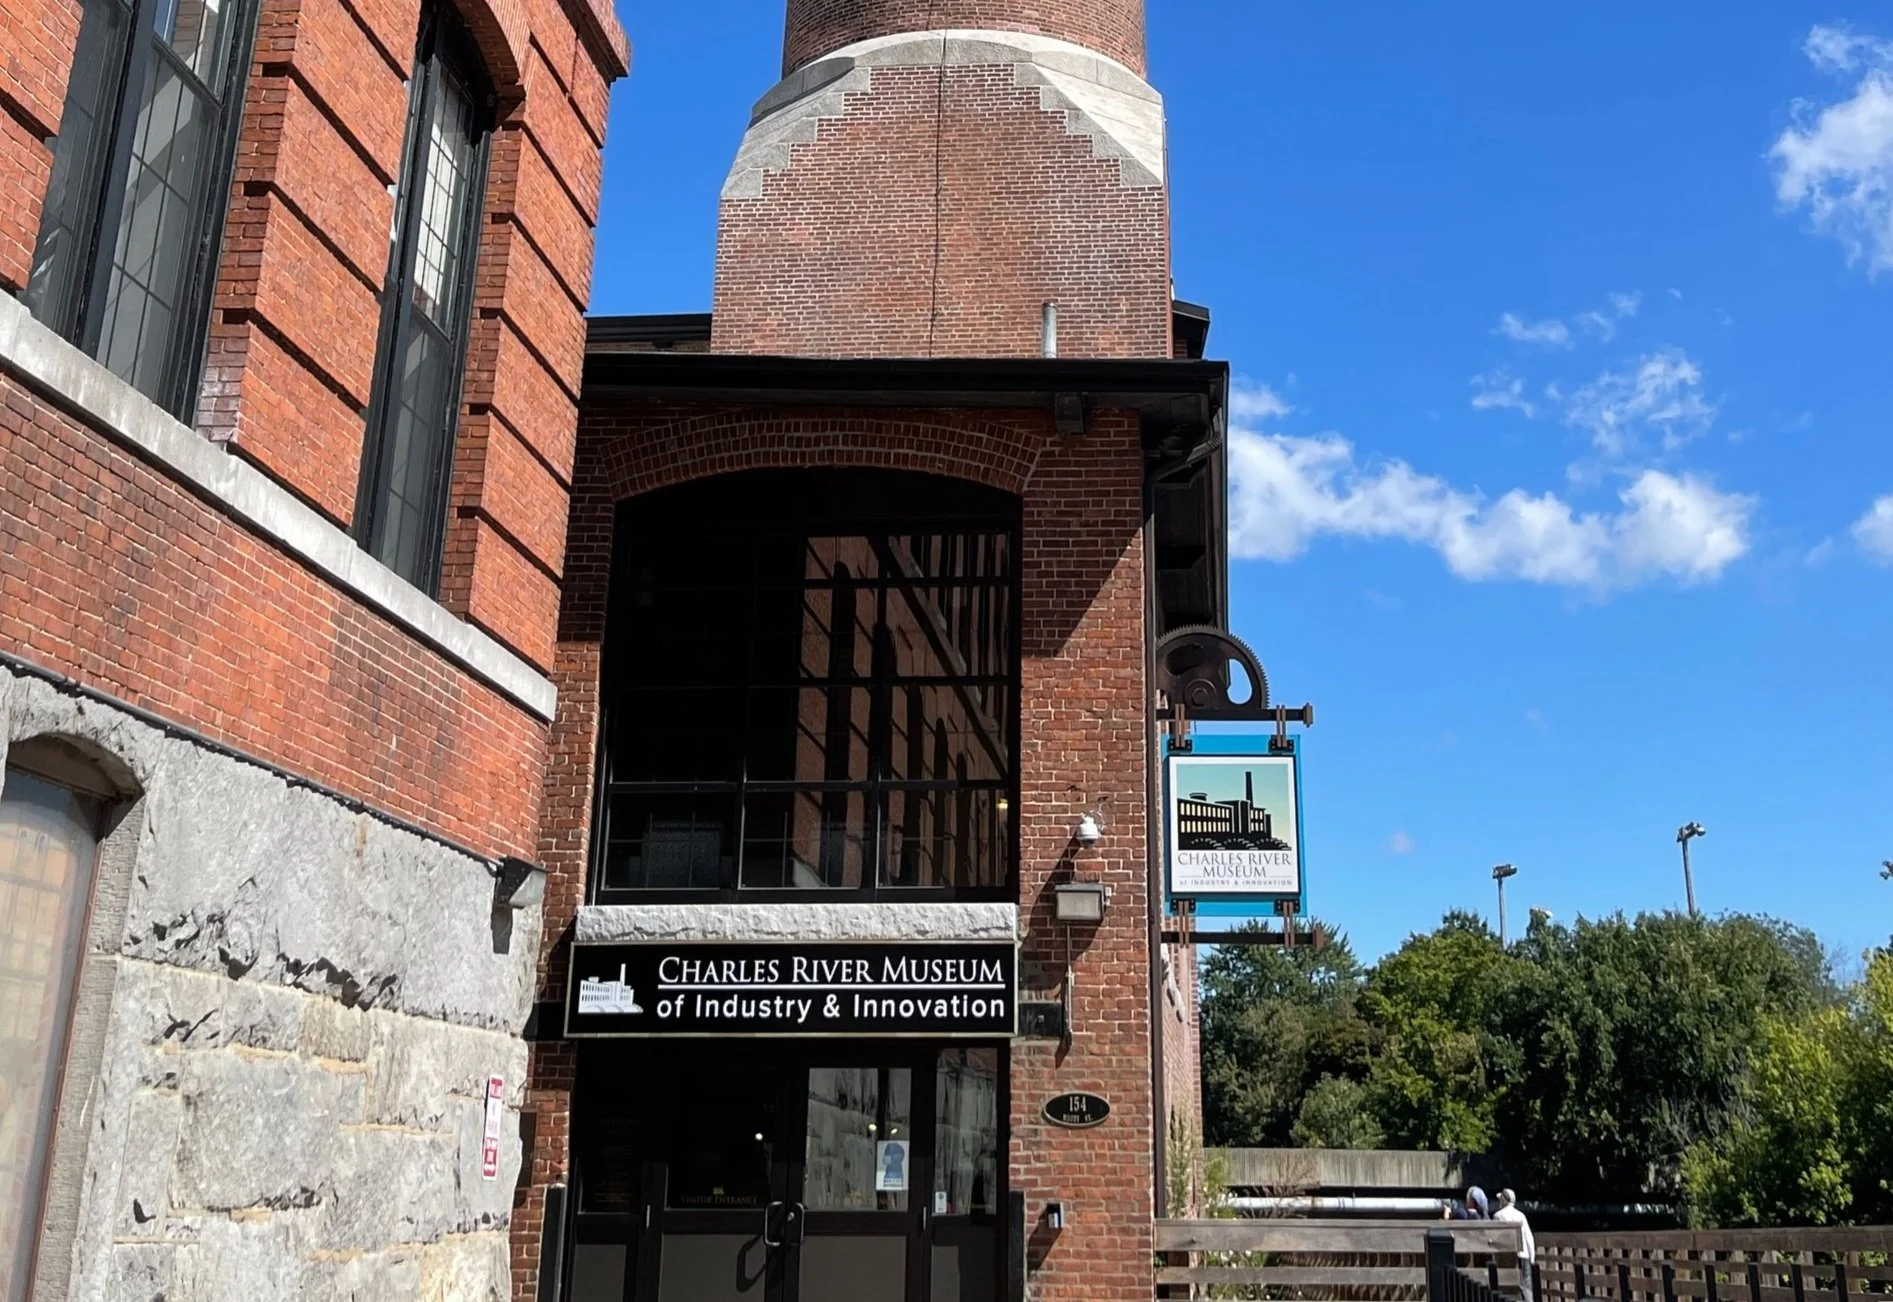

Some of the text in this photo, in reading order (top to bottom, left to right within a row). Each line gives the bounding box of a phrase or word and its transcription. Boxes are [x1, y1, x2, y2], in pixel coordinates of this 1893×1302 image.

[1178, 852, 1292, 866] CHARLES RIVER
[1202, 865, 1267, 878] MUSEUM
[657, 956, 1004, 984] CHARLES RIVER MUSEUM
[657, 993, 1006, 1024] of Industry & Innovation
[1069, 1096, 1087, 1112] 154
